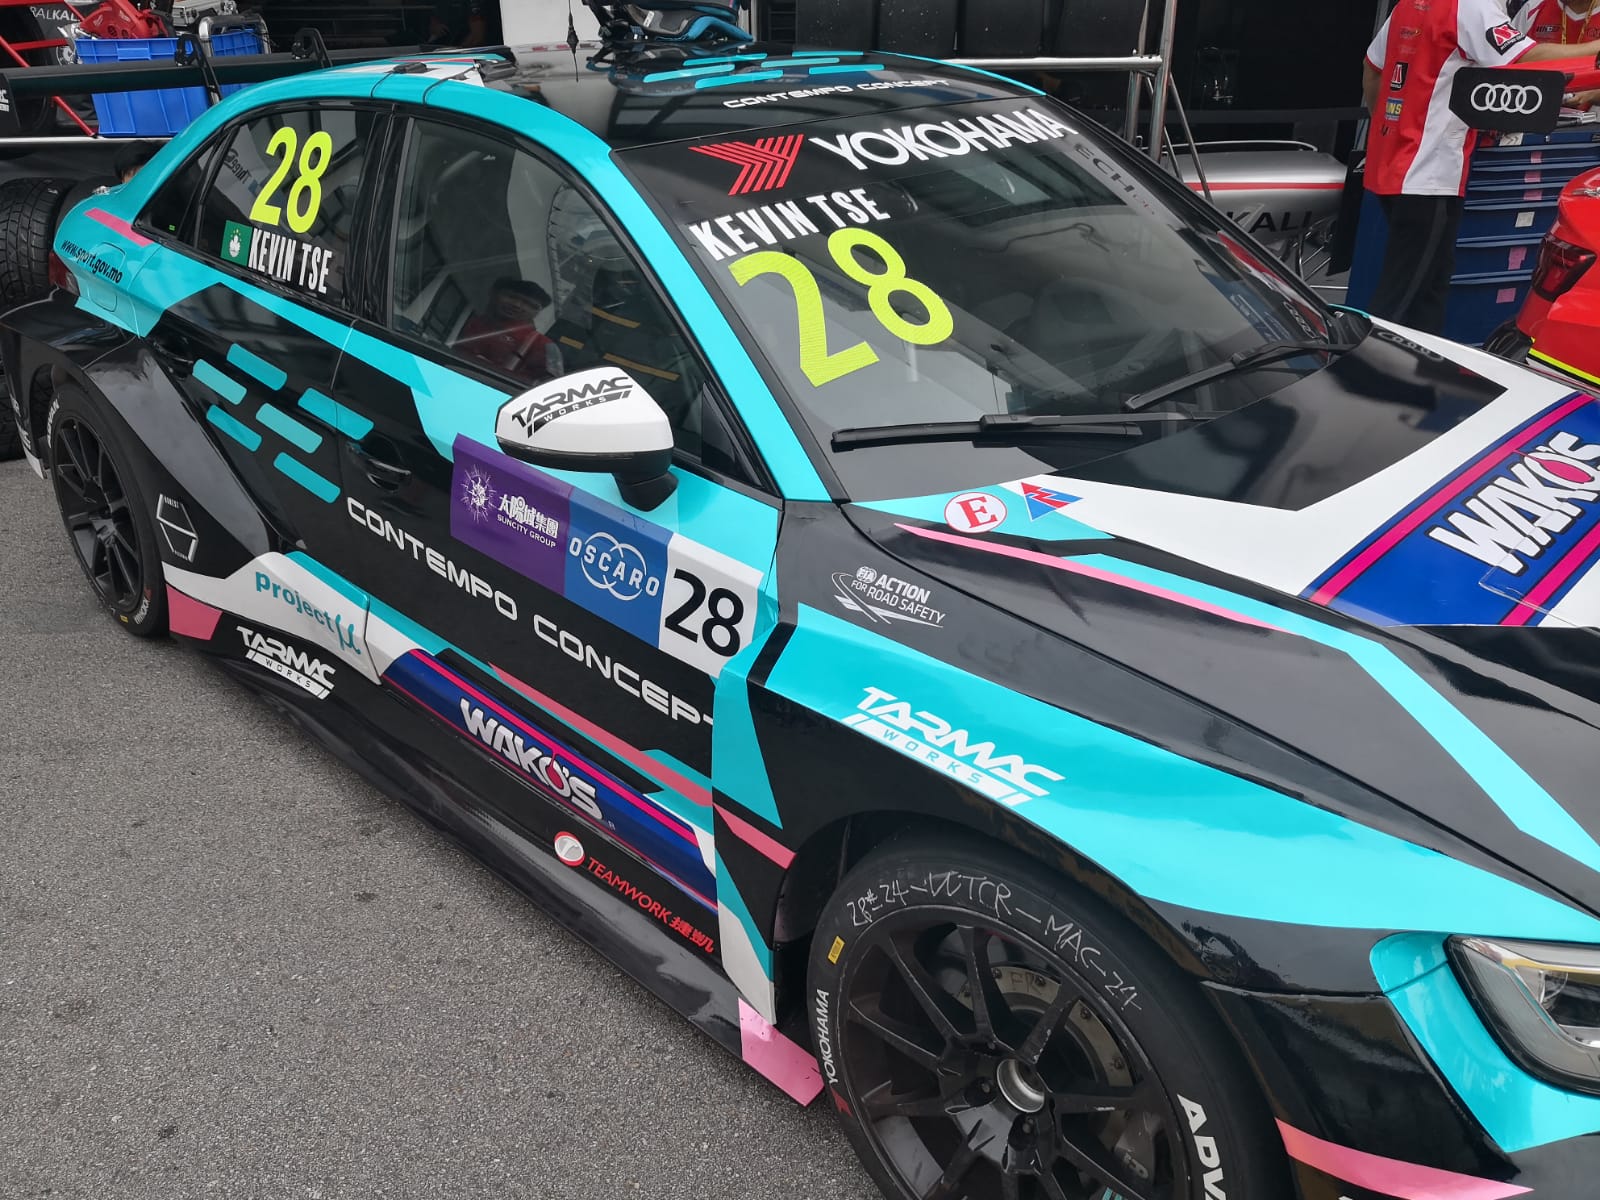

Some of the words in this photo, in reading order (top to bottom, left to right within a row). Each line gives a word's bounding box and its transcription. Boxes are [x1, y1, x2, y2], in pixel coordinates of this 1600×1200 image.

[723, 85, 853, 109] CONTEMPO
[856, 79, 950, 91] CONCEPT
[808, 108, 1079, 171] YOKOHAMA
[250, 126, 333, 234] 28
[688, 200, 820, 261] KEVIN
[806, 188, 891, 228] TSE
[248, 227, 297, 282] KEVIN
[298, 242, 333, 294] TSE
[728, 227, 954, 388] 28
[511, 376, 633, 429] TARMAC
[543, 396, 607, 422] WORKS
[497, 514, 528, 535] SUNCITY
[530, 530, 556, 548] GROUP
[956, 496, 998, 529] E
[346, 496, 518, 621] CONTEMPO
[569, 537, 660, 597] OSCARO
[875, 574, 931, 605] ACTION
[664, 567, 744, 657] 28
[851, 579, 868, 592] FOR
[866, 586, 899, 607] ROAD
[898, 598, 946, 624] SAFETY
[236, 625, 336, 690] TARMAC
[265, 658, 312, 688] WORKS
[856, 686, 1067, 797] TARMAC
[883, 728, 983, 784] WORKS
[586, 856, 673, 924] TEAMWORK
[816, 988, 839, 1085] YOKOHAMA
